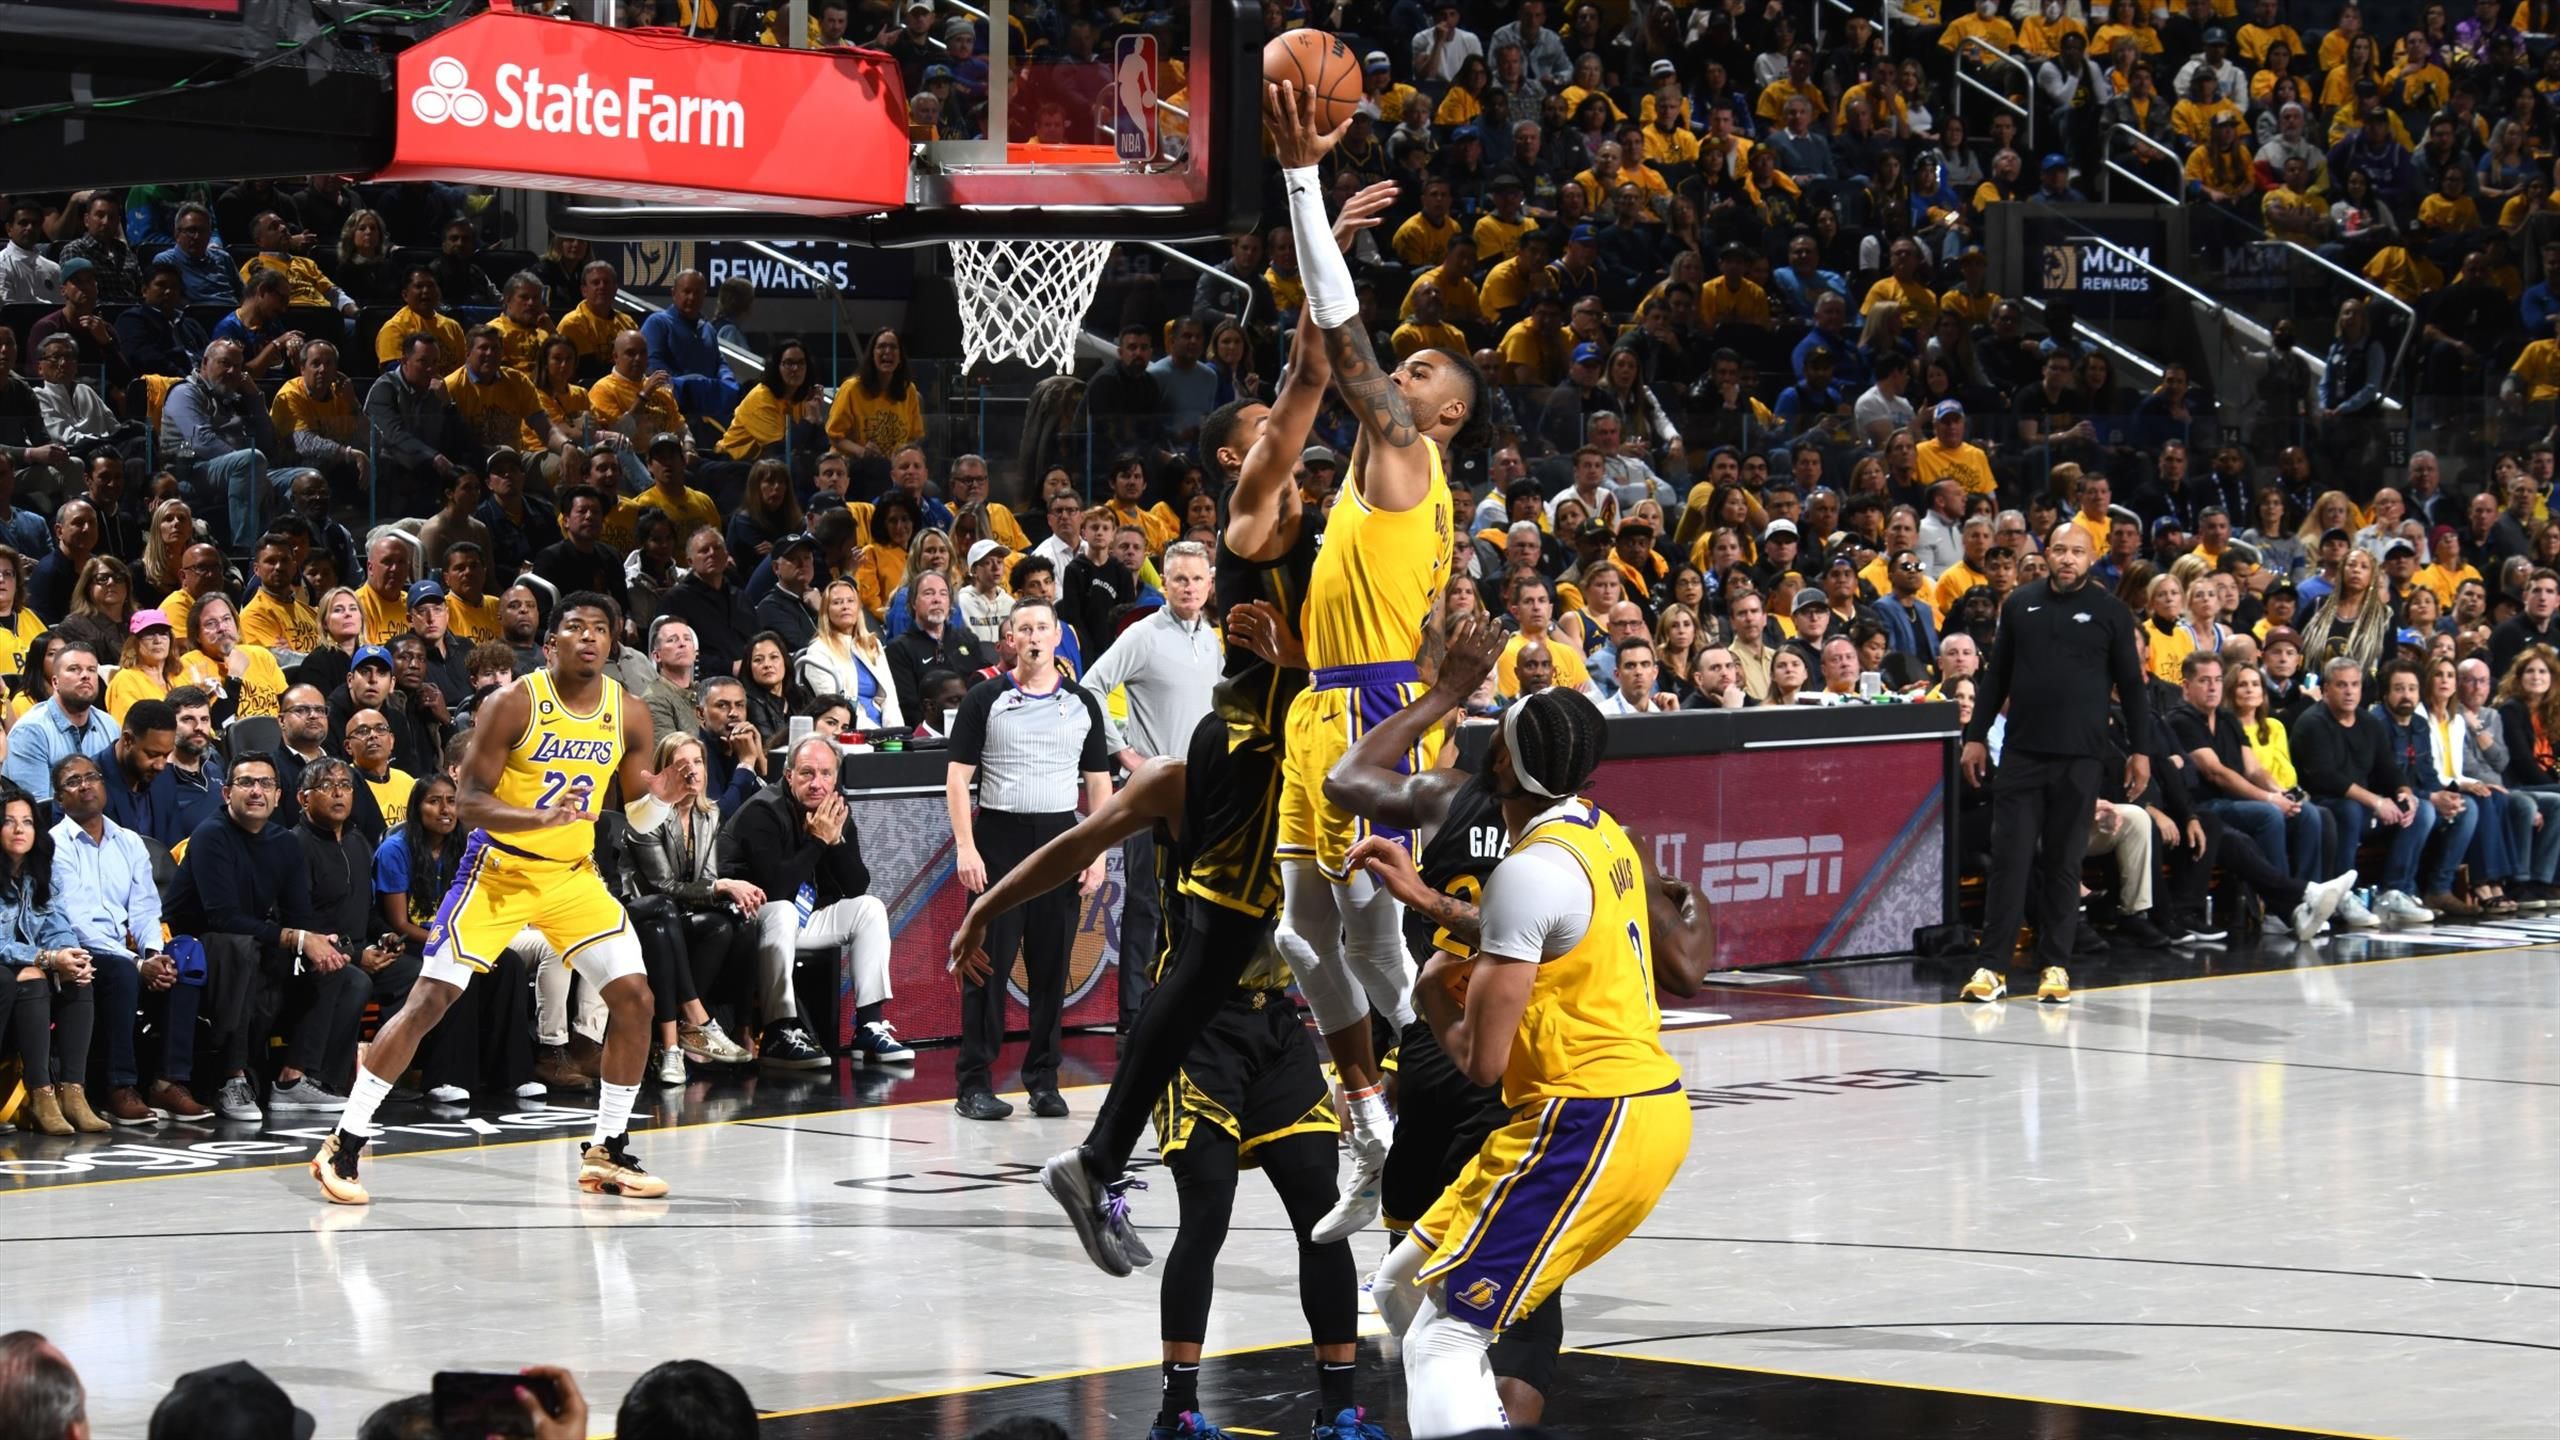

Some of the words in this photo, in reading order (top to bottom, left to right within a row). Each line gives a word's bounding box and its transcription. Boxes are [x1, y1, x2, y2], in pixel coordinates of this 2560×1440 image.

[1121, 133, 1142, 153] NBA
[2082, 246, 2150, 273] MGM
[2082, 277, 2150, 292] REWARDS
[2222, 429, 2238, 442] 14
[541, 702, 552, 713] 6
[527, 732, 614, 766] LAKERS
[1700, 833, 1844, 905] ESPN
